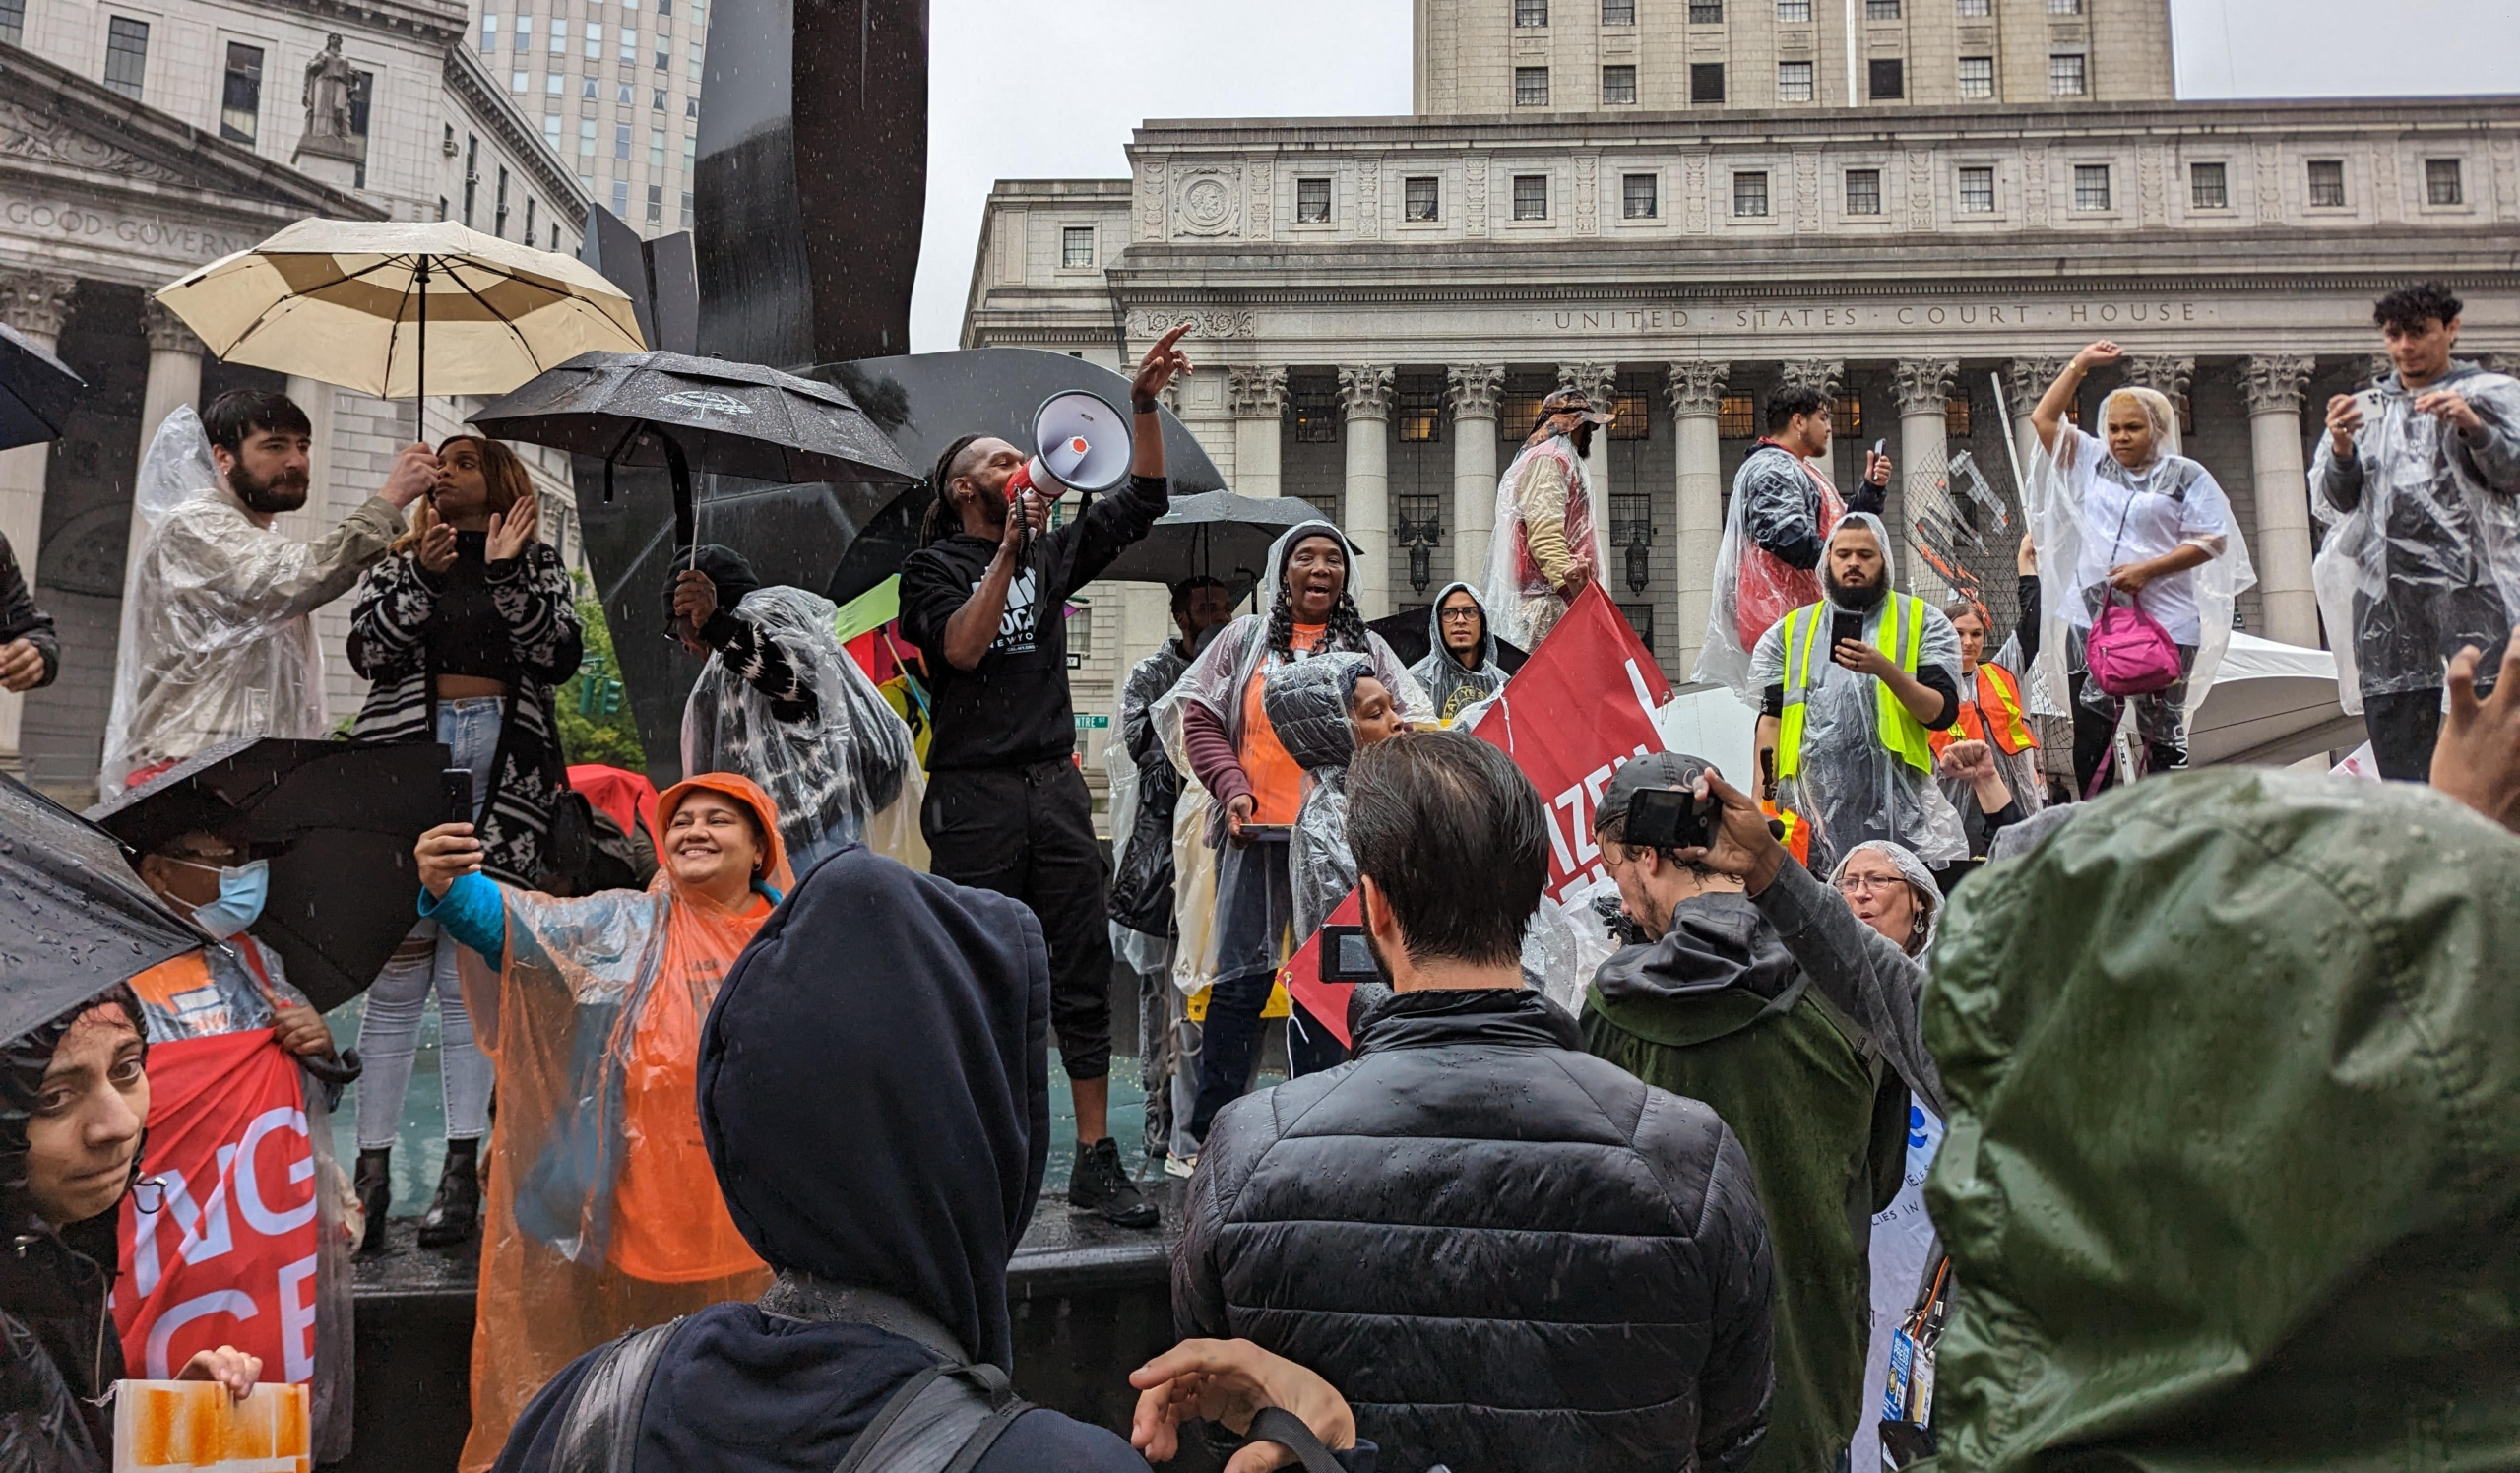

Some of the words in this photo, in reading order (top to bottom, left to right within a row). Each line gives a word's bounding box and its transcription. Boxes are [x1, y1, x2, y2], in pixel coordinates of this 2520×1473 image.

[7, 202, 102, 235] GOOD
[116, 220, 248, 257] GOVERN
[1555, 310, 1688, 329] UNITED
[1736, 308, 1857, 328] STATES
[1897, 305, 2029, 325] COURT
[2071, 303, 2194, 322] HOUSE
[999, 606, 1034, 635] OCA
[1018, 632, 1034, 642] YO
[1075, 716, 1096, 728] NTRE
[2169, 725, 2189, 769] lvin
[134, 1106, 318, 1299] NG
[1870, 1210, 1898, 1227] LIES
[1902, 1201, 1920, 1215] IN
